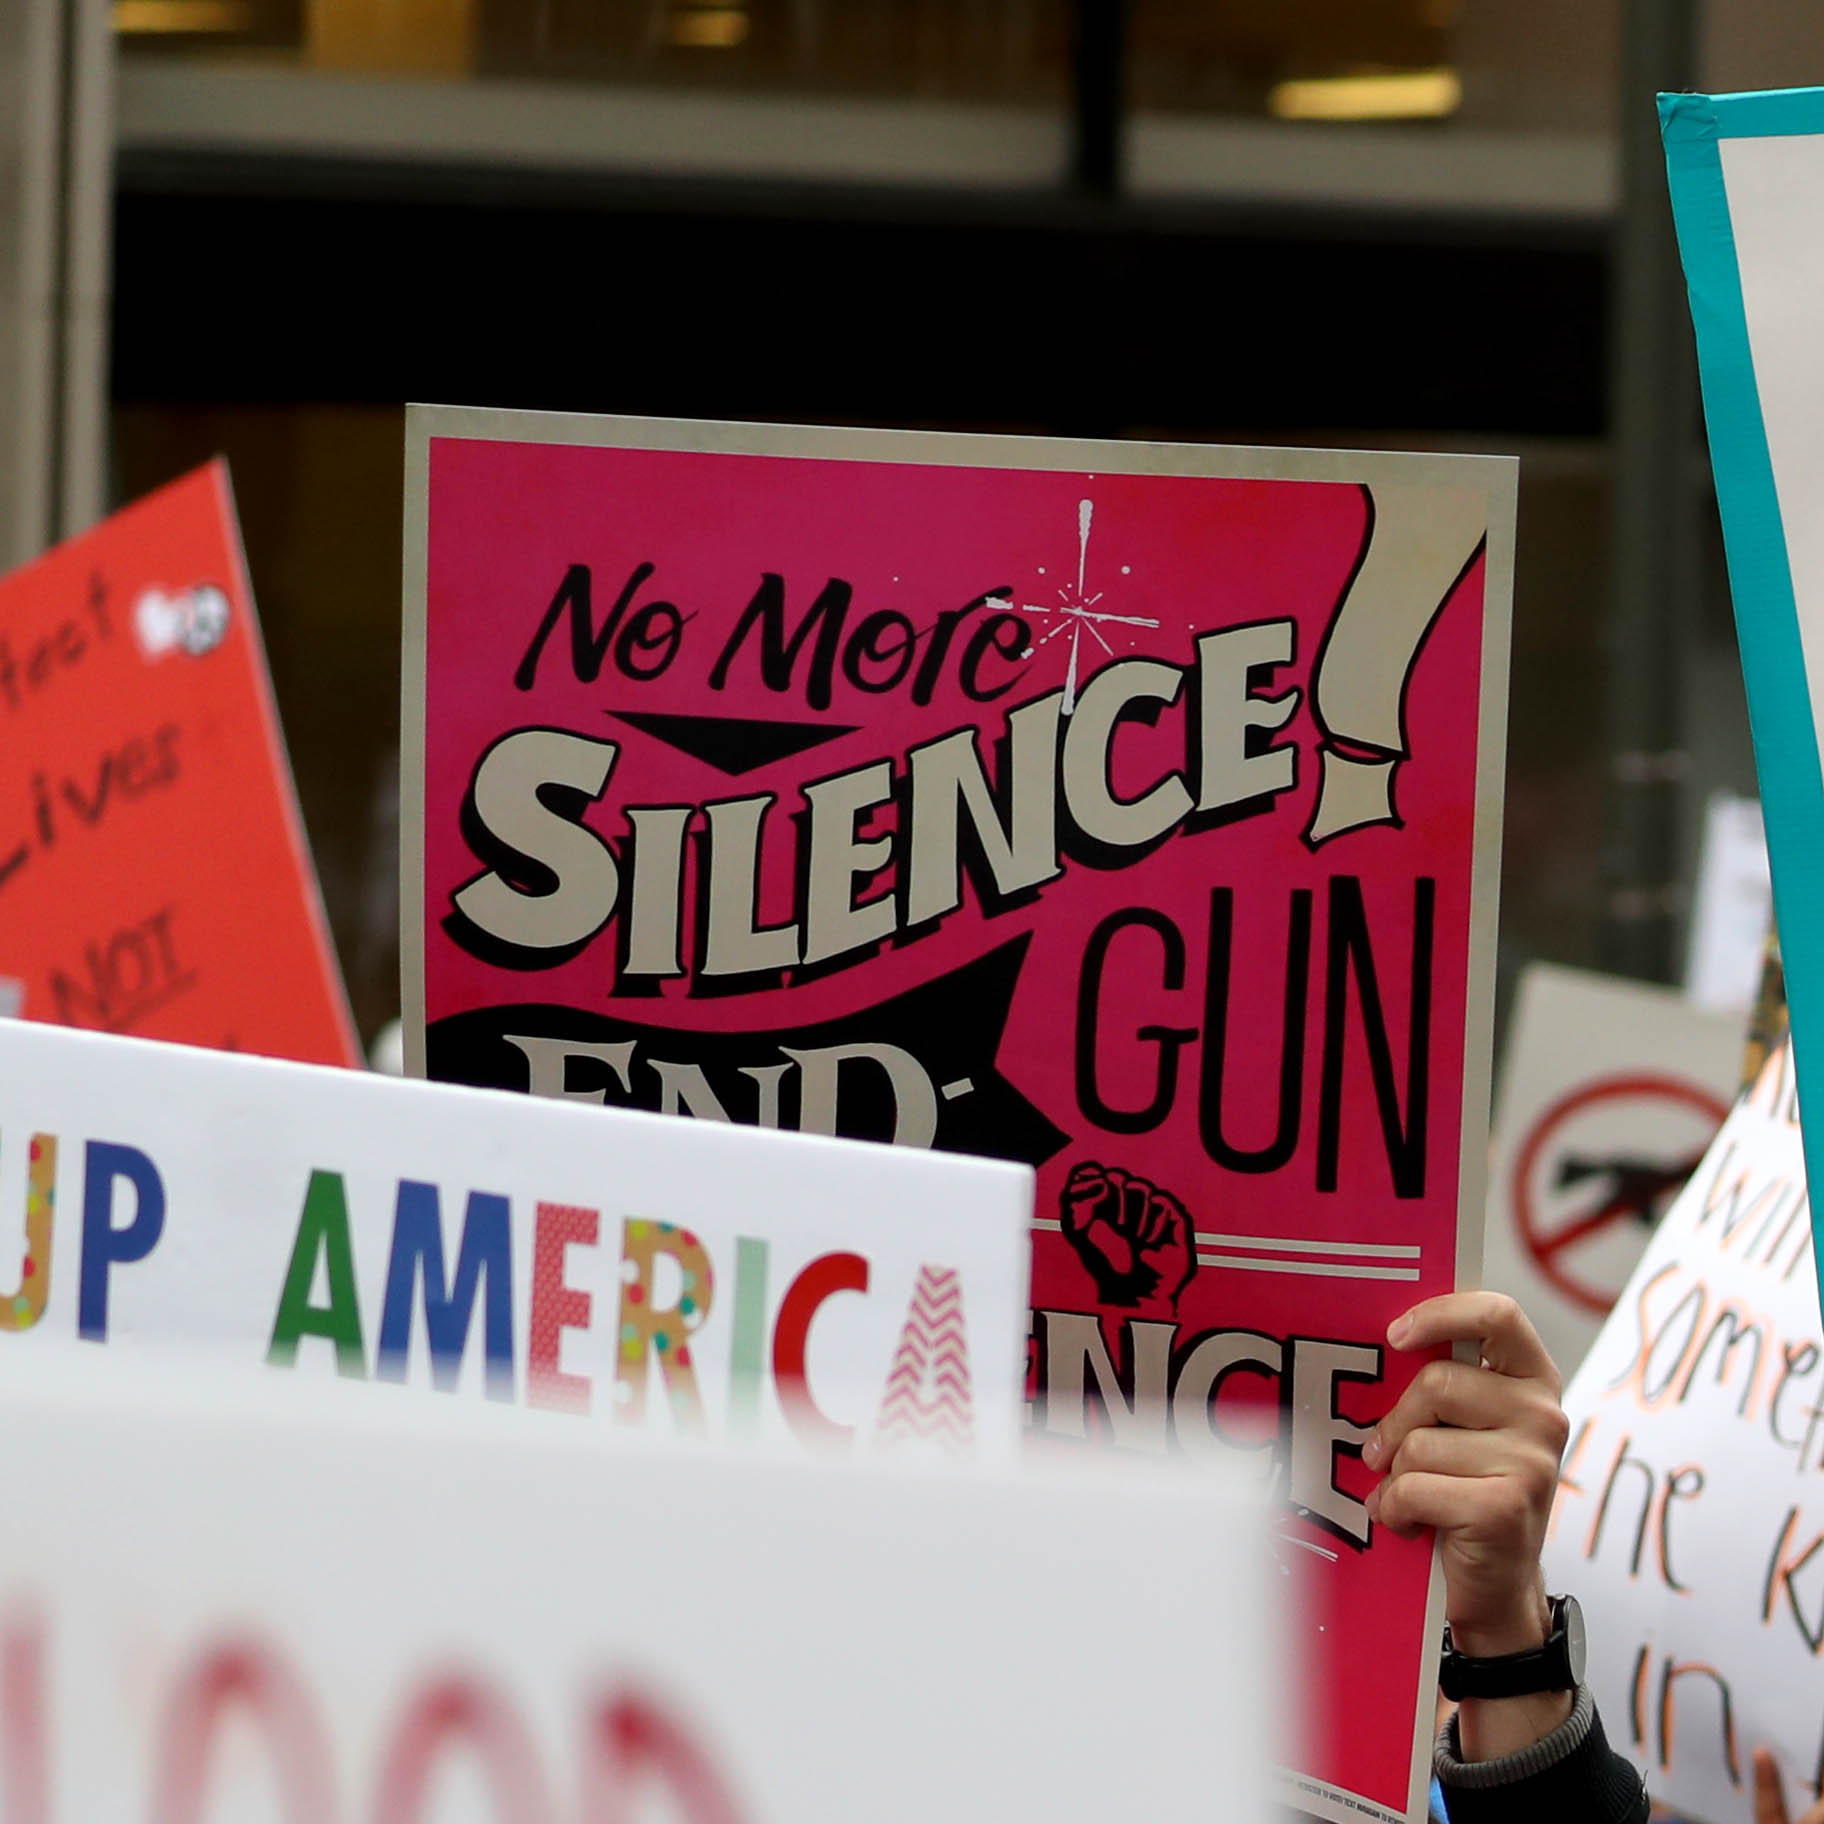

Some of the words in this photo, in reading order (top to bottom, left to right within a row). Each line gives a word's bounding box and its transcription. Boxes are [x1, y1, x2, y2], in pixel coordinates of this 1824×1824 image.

[516, 562, 698, 690] No
[709, 572, 1033, 710] More
[1074, 875, 1435, 1199] GUN
[265, 1168, 978, 1458] AMERICA
[1028, 1307, 1384, 1551] NCE
